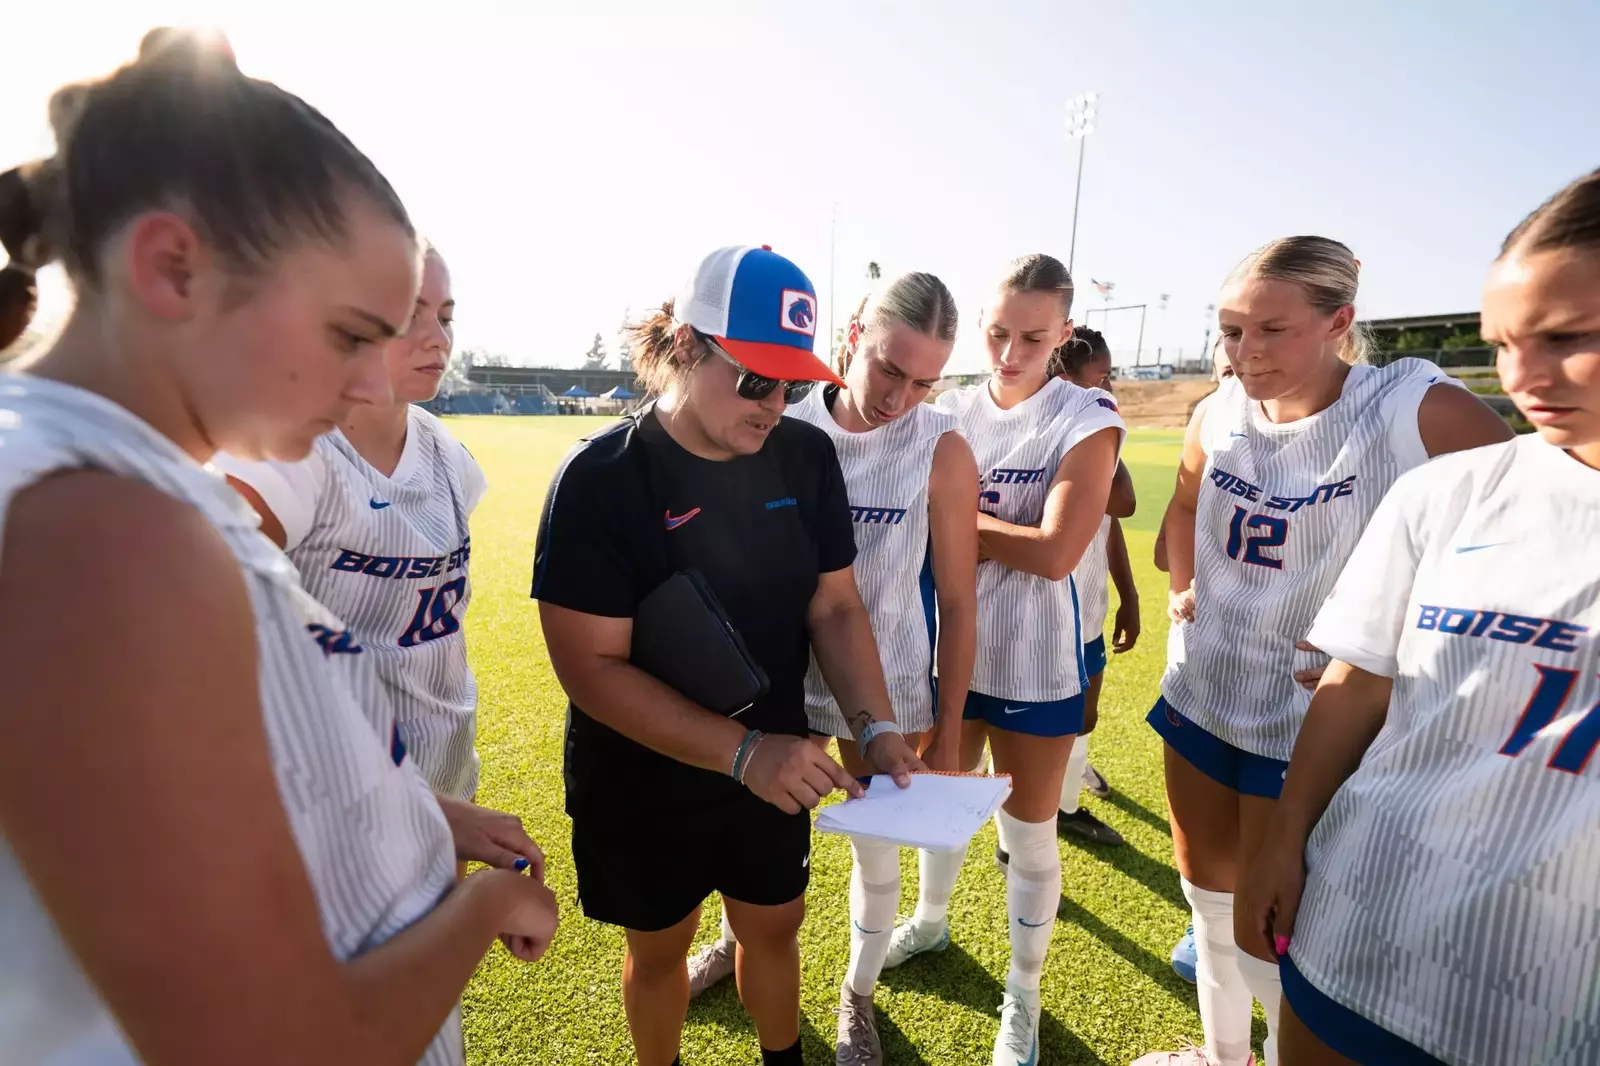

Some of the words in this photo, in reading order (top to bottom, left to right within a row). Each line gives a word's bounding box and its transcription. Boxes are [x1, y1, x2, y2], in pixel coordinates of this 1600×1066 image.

[1210, 467, 1264, 503] OISE
[850, 506, 908, 525] TAT
[1226, 504, 1289, 571] 12
[330, 548, 448, 580] BOISE
[1416, 604, 1590, 653] BOISE
